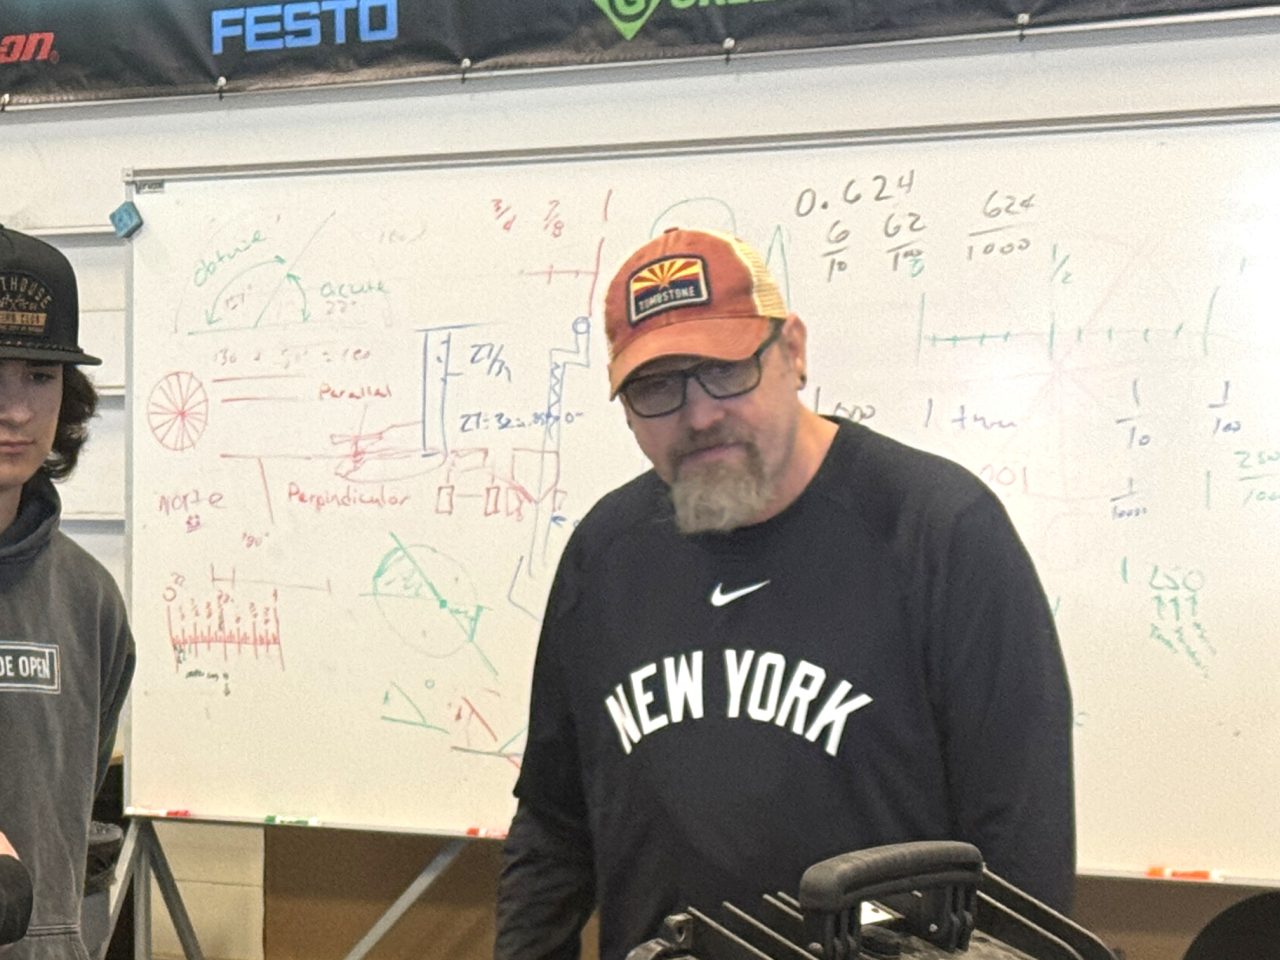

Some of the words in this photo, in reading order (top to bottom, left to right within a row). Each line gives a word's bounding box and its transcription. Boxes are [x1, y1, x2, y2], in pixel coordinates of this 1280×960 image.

[211, 0, 398, 55] FESTO
[638, 286, 696, 312] TOMBSTONE
[18, 654, 51, 679] OPEN
[605, 650, 705, 755] NEW
[724, 649, 874, 757] YORK
